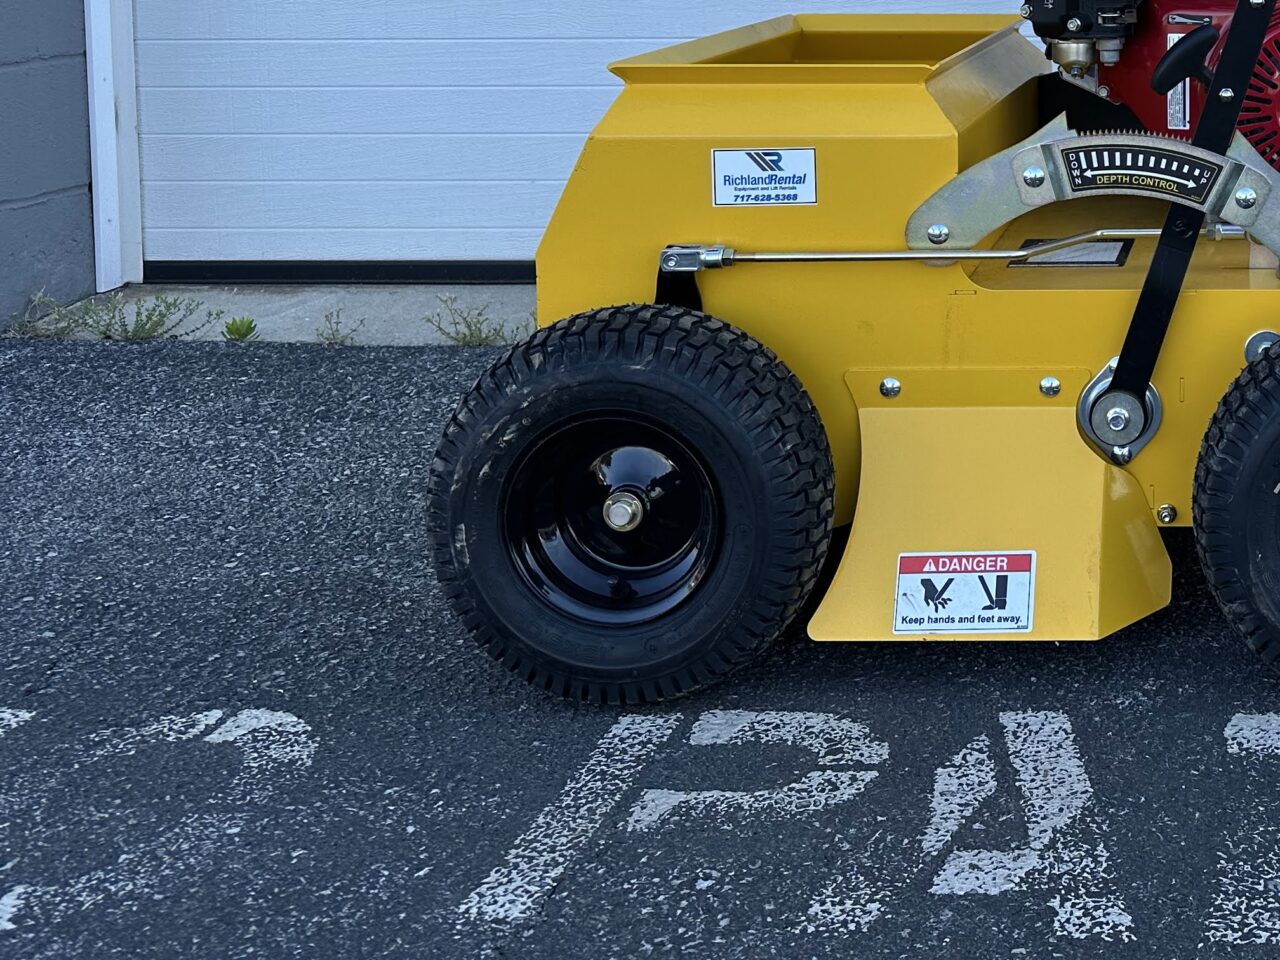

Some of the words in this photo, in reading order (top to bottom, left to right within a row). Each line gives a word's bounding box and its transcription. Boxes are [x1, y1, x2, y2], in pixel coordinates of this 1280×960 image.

[1069, 153, 1082, 185] DOWN
[1096, 175, 1131, 184] DEPTH
[1132, 176, 1179, 192] CONTROL
[1200, 170, 1211, 185] UP
[733, 194, 798, 202] 717-628-5368
[938, 556, 1008, 571] DANGER
[901, 615, 925, 625] Keep
[927, 615, 955, 624] hands
[957, 615, 975, 623] and
[977, 614, 995, 623] feet
[997, 615, 1022, 625] away.
